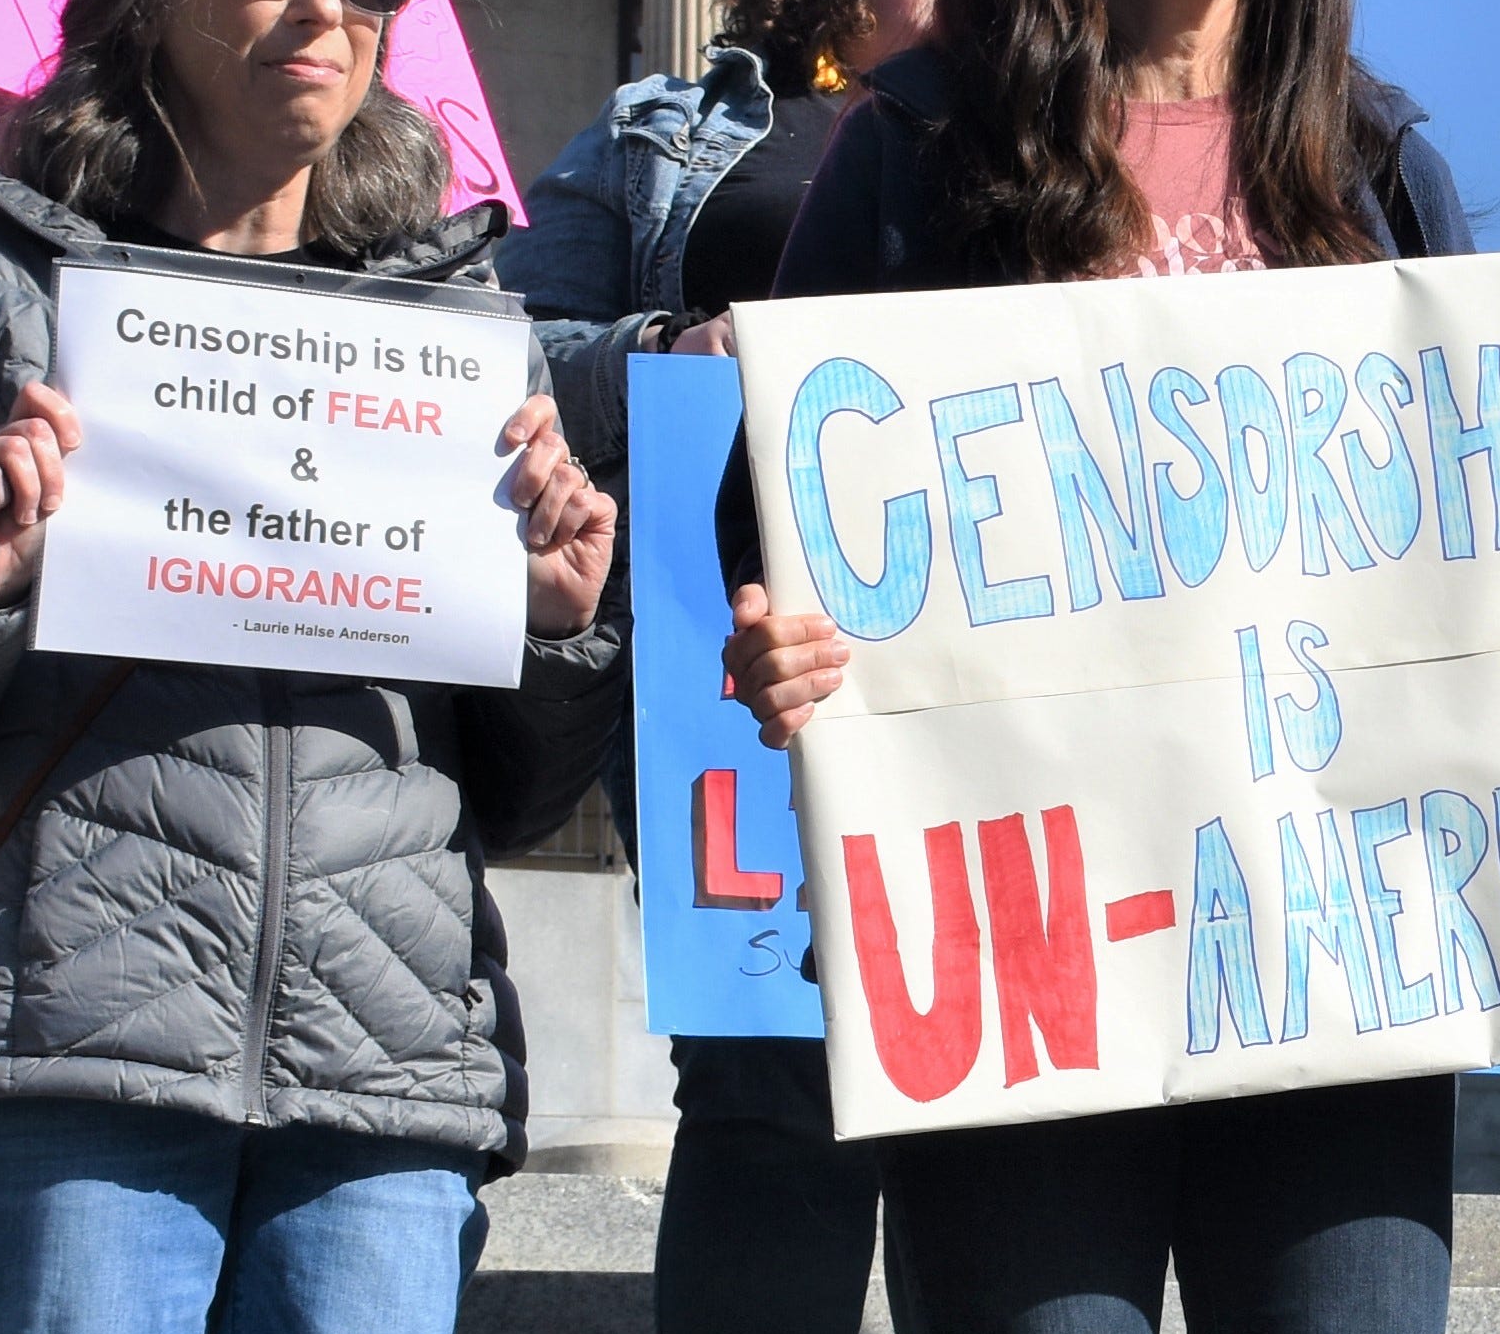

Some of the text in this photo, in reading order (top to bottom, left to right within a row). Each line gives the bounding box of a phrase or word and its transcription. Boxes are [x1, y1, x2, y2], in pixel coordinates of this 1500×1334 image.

[115, 308, 482, 382] Censorship is the
[153, 375, 444, 437] child of FEAR
[289, 447, 319, 483] &
[163, 497, 425, 552] the father of
[146, 555, 434, 615] IGNORANCE.
[243, 618, 290, 636] Laurie
[293, 622, 336, 640] Halse
[338, 626, 411, 645] Anderson
[1236, 619, 1343, 783] IS
